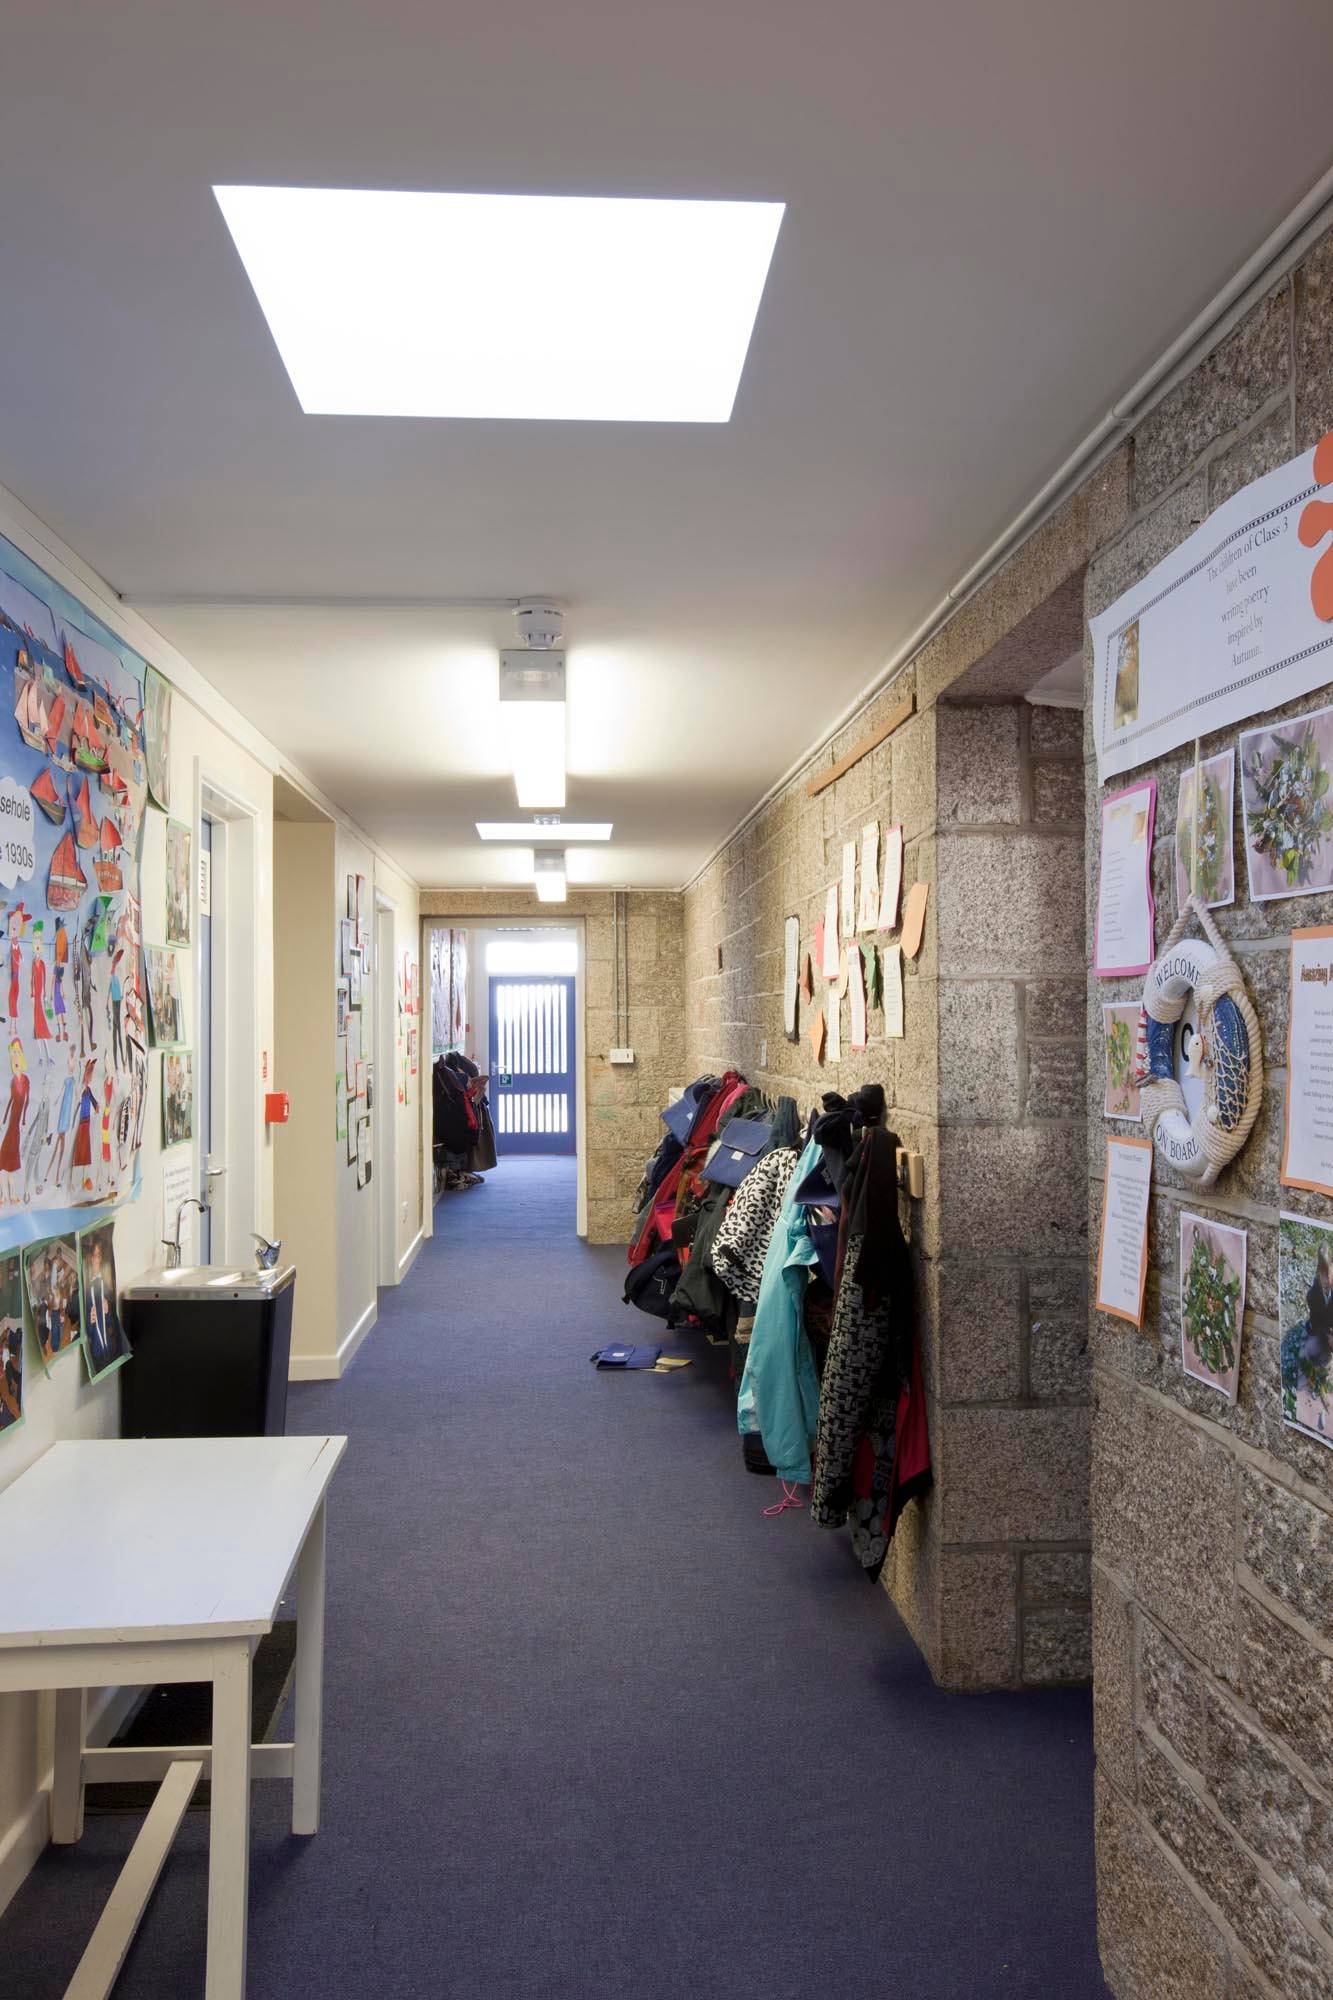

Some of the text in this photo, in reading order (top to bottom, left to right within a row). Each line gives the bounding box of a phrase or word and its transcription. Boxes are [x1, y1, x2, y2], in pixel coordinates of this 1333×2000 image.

[1207, 516, 1289, 582] The children of Class 3
[1225, 565, 1257, 595] have been
[1221, 585, 1270, 624] writing poetry
[1227, 613, 1264, 646] inspired by
[0, 795, 31, 821] sehole
[5, 841, 34, 869] 1930s
[1156, 1124, 1169, 1151] ON
